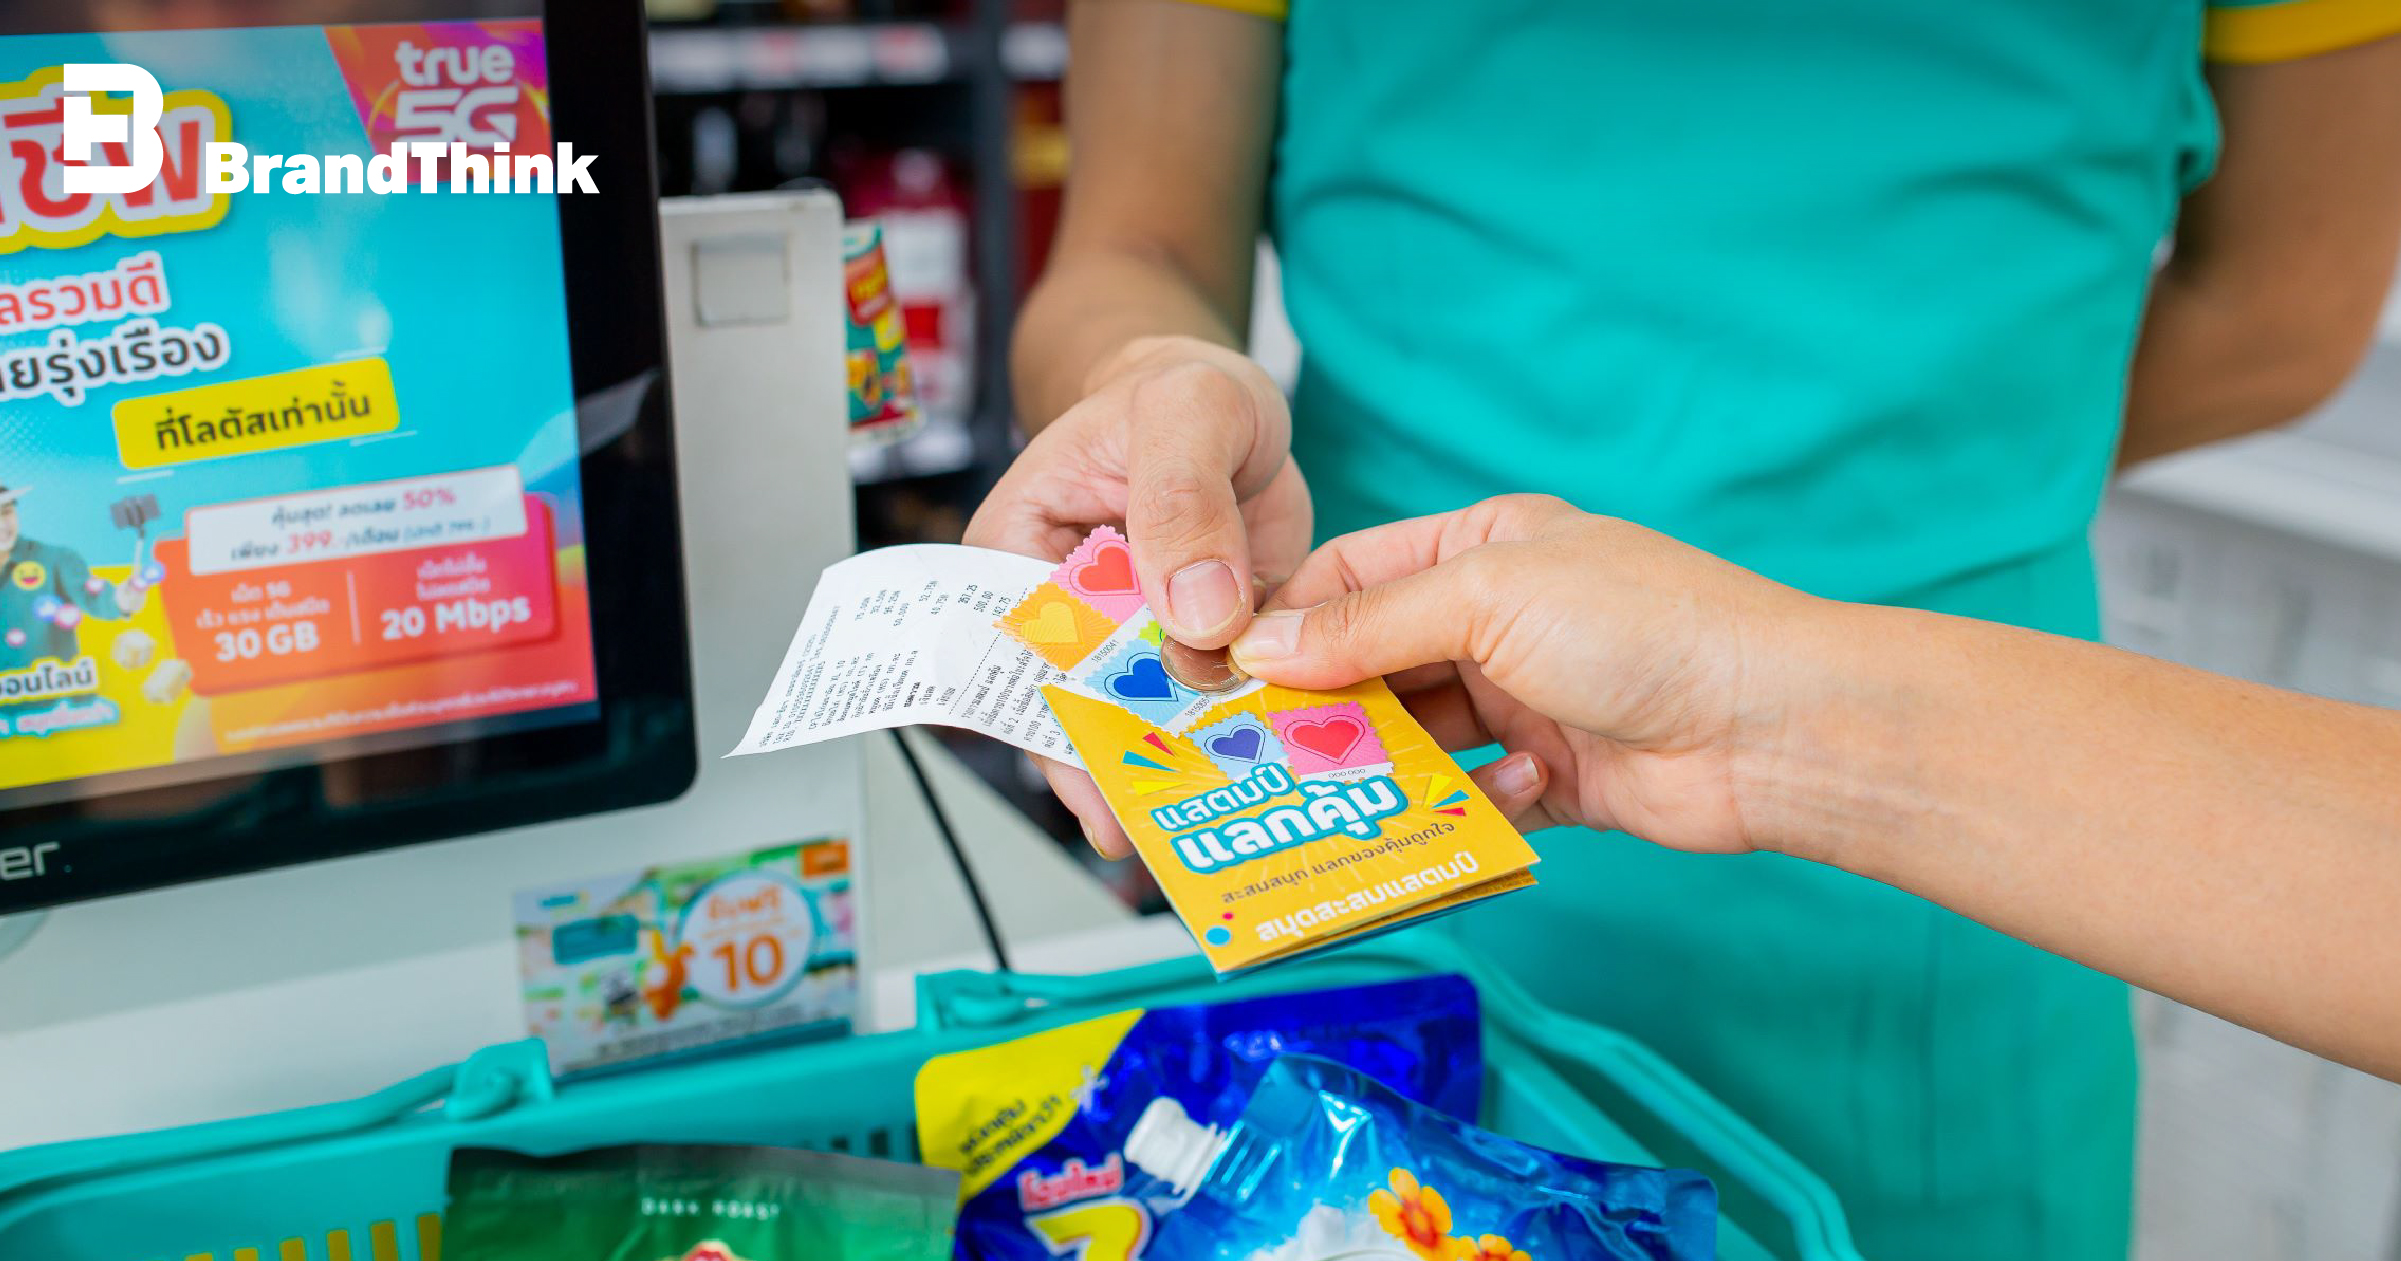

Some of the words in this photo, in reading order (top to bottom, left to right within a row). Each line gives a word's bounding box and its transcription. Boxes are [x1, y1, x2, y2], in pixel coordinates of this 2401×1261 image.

[395, 41, 516, 86] true
[395, 86, 519, 152] 5G
[154, 378, 372, 451] ที่โลตัสเท่านั้น
[402, 488, 457, 510] 50%
[380, 607, 427, 641] 20
[435, 596, 531, 634] Mbps
[974, 591, 993, 612] 500.00
[214, 628, 261, 662] 30
[267, 621, 319, 655] GB
[1176, 779, 1400, 869] แลกคุ้ม
[1221, 868, 1309, 905] สะสมสนุก
[1311, 821, 1456, 877] แลกของคุ้มถูกใจ
[711, 932, 783, 993] 10
